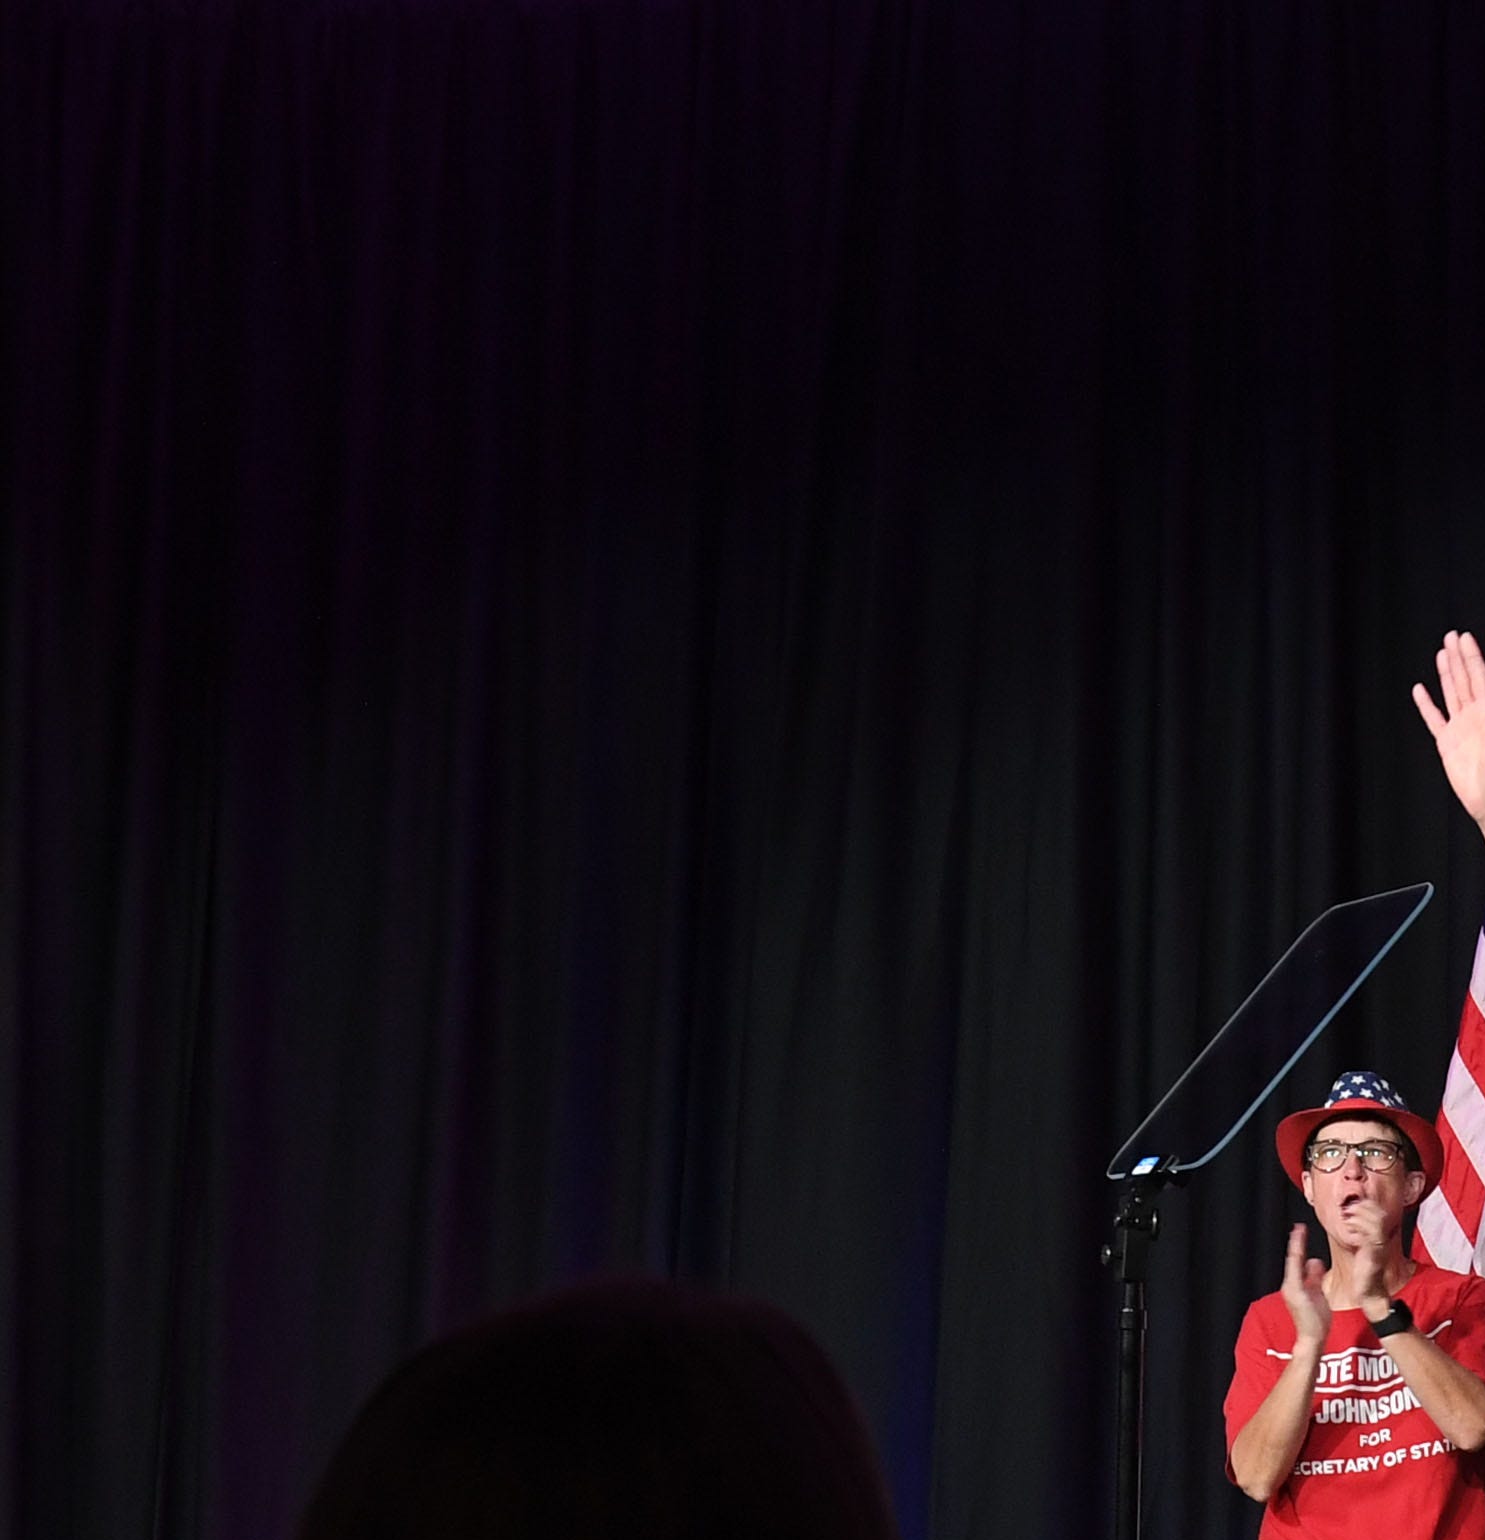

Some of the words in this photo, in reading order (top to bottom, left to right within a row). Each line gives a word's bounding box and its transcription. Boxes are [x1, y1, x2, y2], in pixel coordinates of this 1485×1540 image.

[1359, 1428, 1391, 1447] FOR
[1383, 1448, 1407, 1467] OF
[1410, 1439, 1457, 1460] STAT
